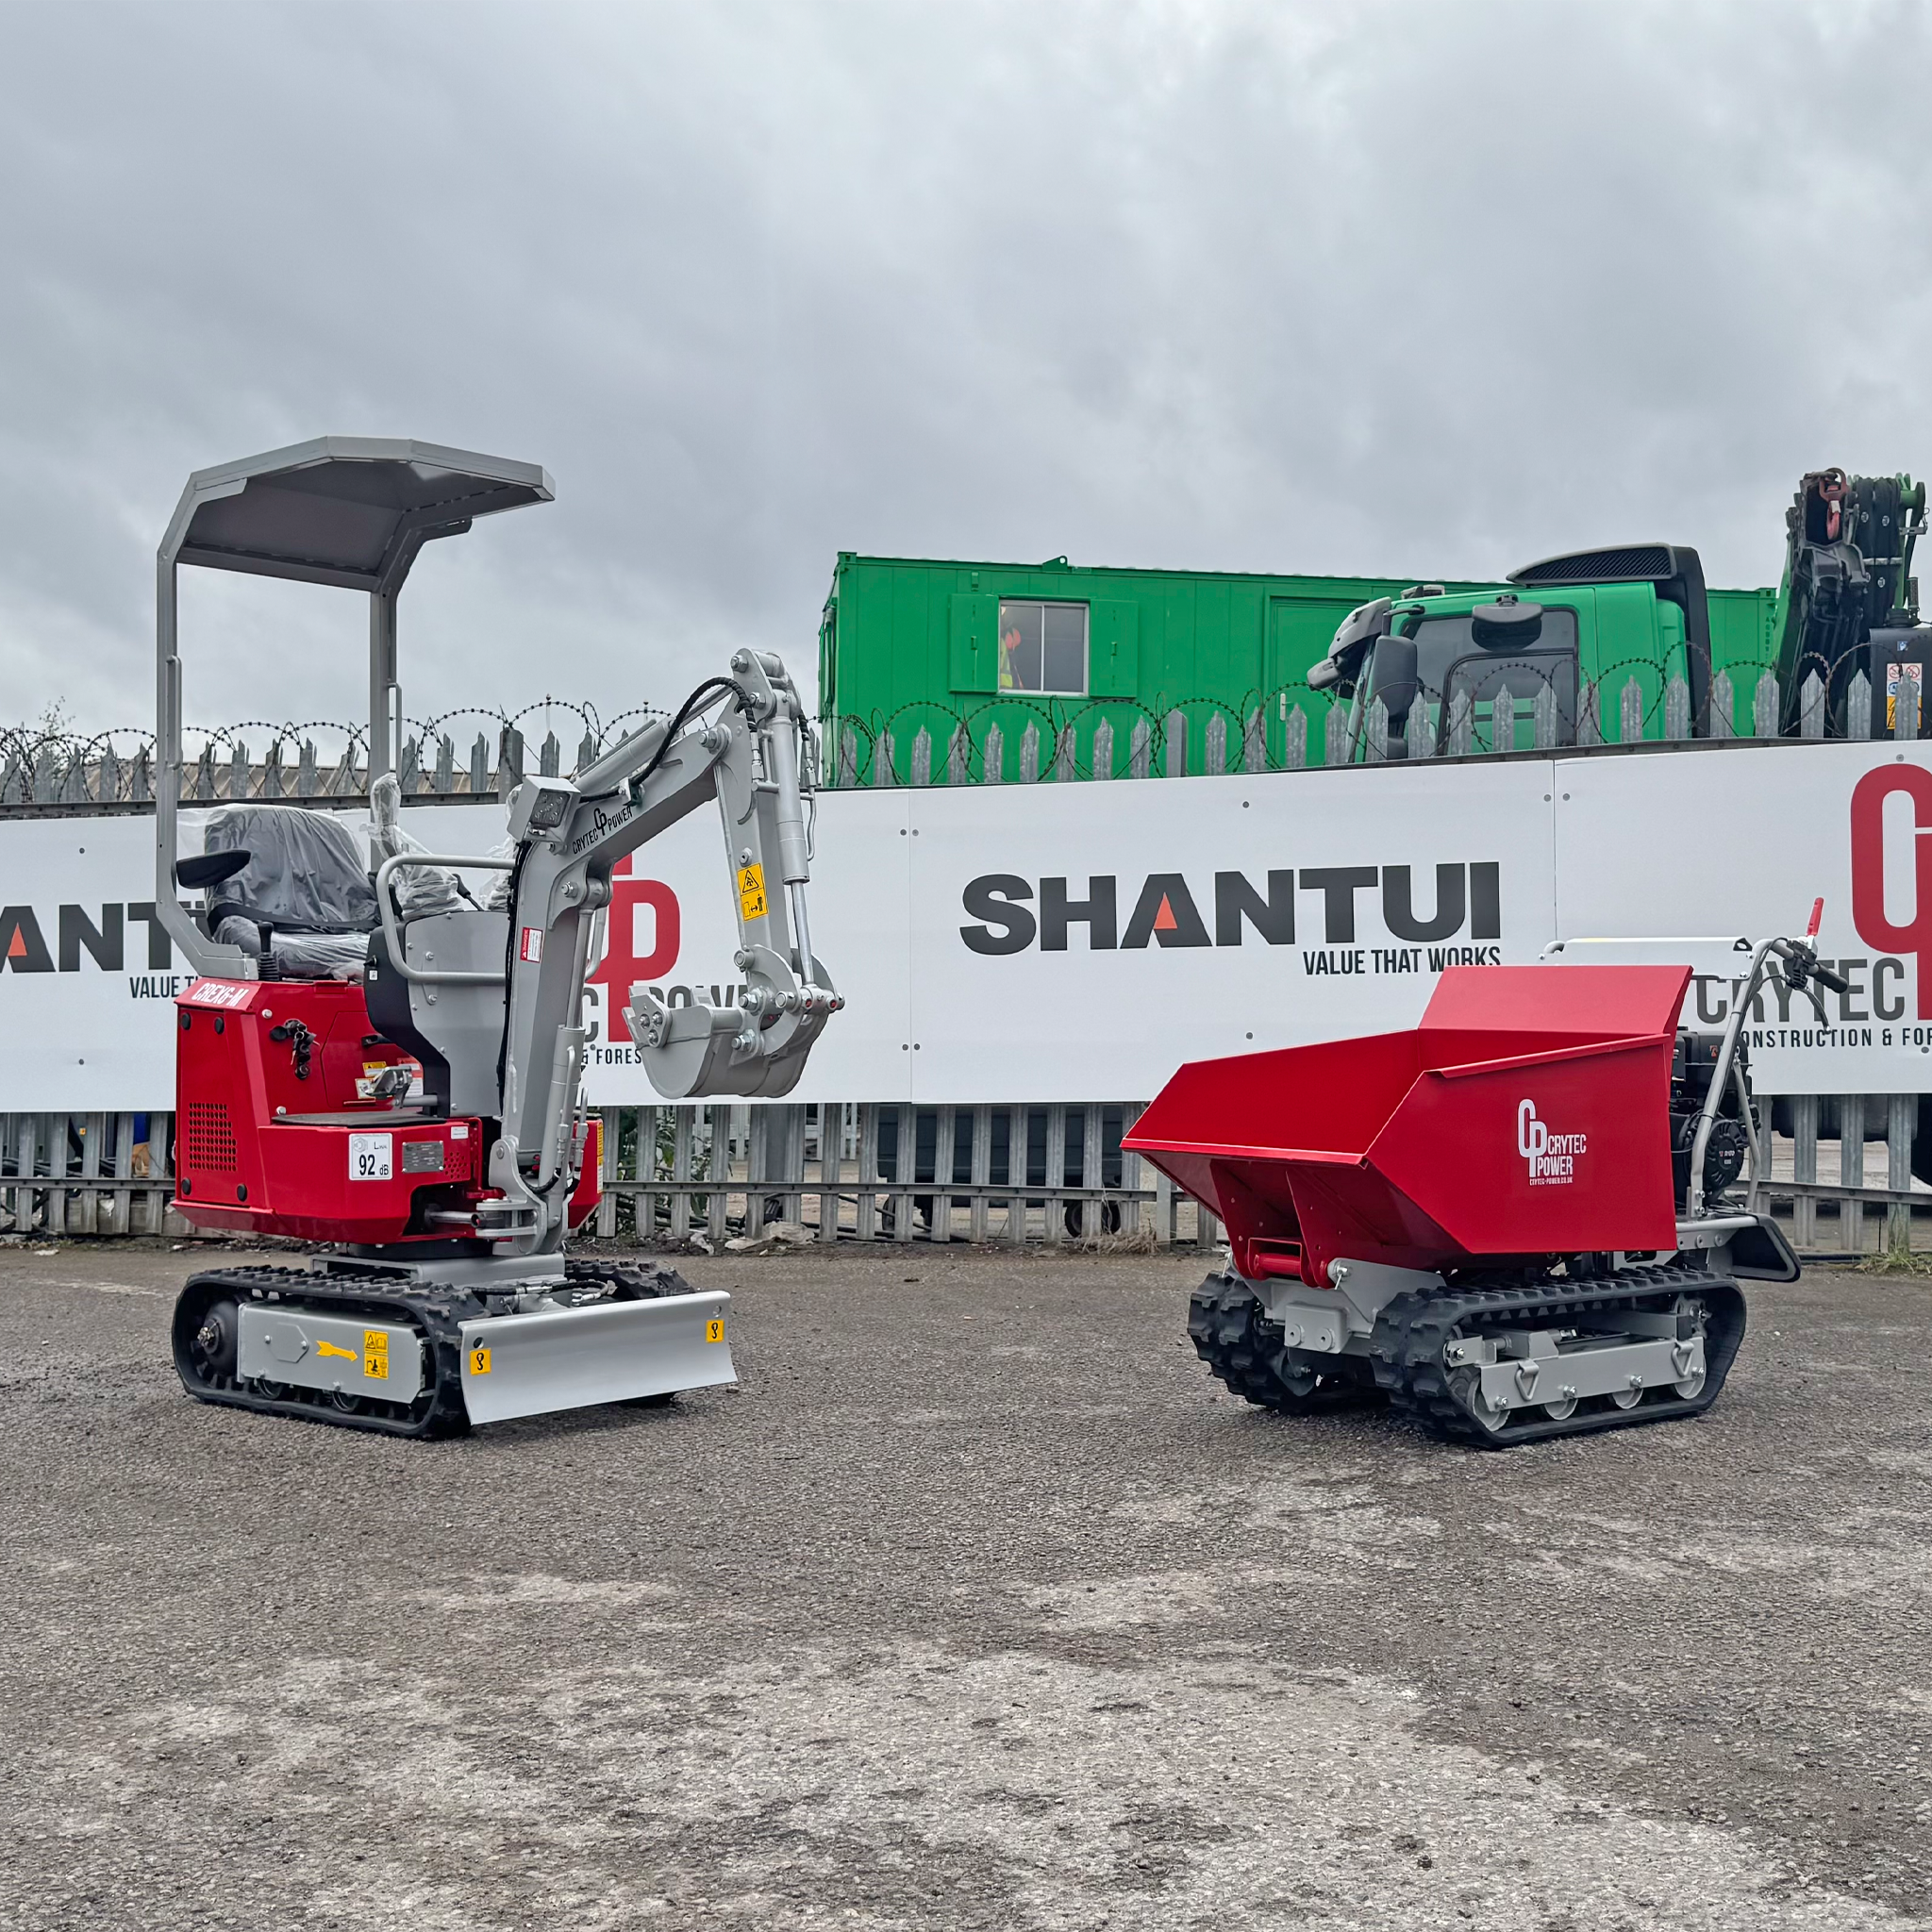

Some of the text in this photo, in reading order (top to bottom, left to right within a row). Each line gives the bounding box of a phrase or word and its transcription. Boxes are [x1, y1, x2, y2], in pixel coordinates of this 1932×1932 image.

[573, 828, 598, 854] CRYTEC
[608, 806, 633, 831] POWER
[959, 861, 1501, 956] SHANTUI
[1303, 946, 1501, 974] VALUE THAT WORKS
[129, 975, 180, 999] VALUE
[1882, 1028, 1892, 1046] &
[1547, 1134, 1587, 1156] CRYTEC
[358, 1154, 389, 1175] 92 dB
[1537, 1156, 1574, 1177] POWER
